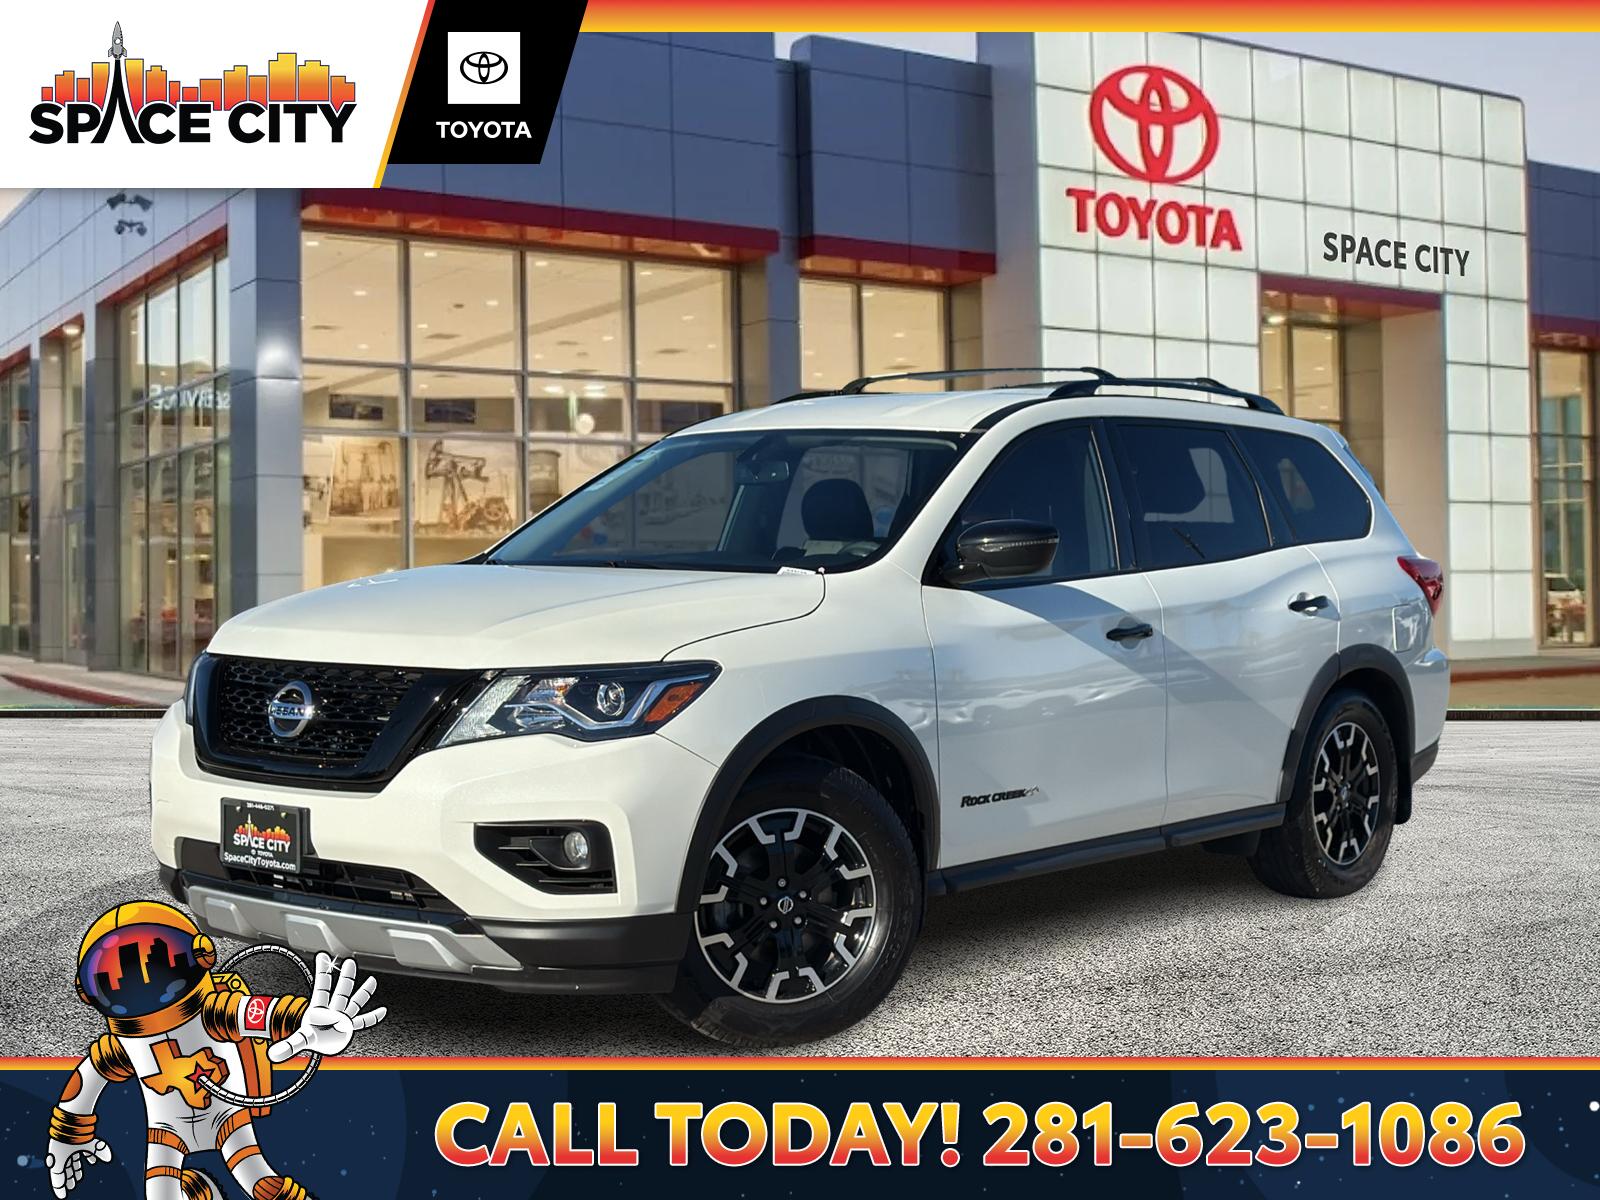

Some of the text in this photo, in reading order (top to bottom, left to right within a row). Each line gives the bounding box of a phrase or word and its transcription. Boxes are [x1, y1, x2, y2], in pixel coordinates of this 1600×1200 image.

[1066, 187, 1242, 251] TOYOTA
[1323, 232, 1470, 277] SPACE CITY
[233, 823, 291, 853] SPACE CITY
[224, 851, 297, 872] SpaceCityToyota.com
